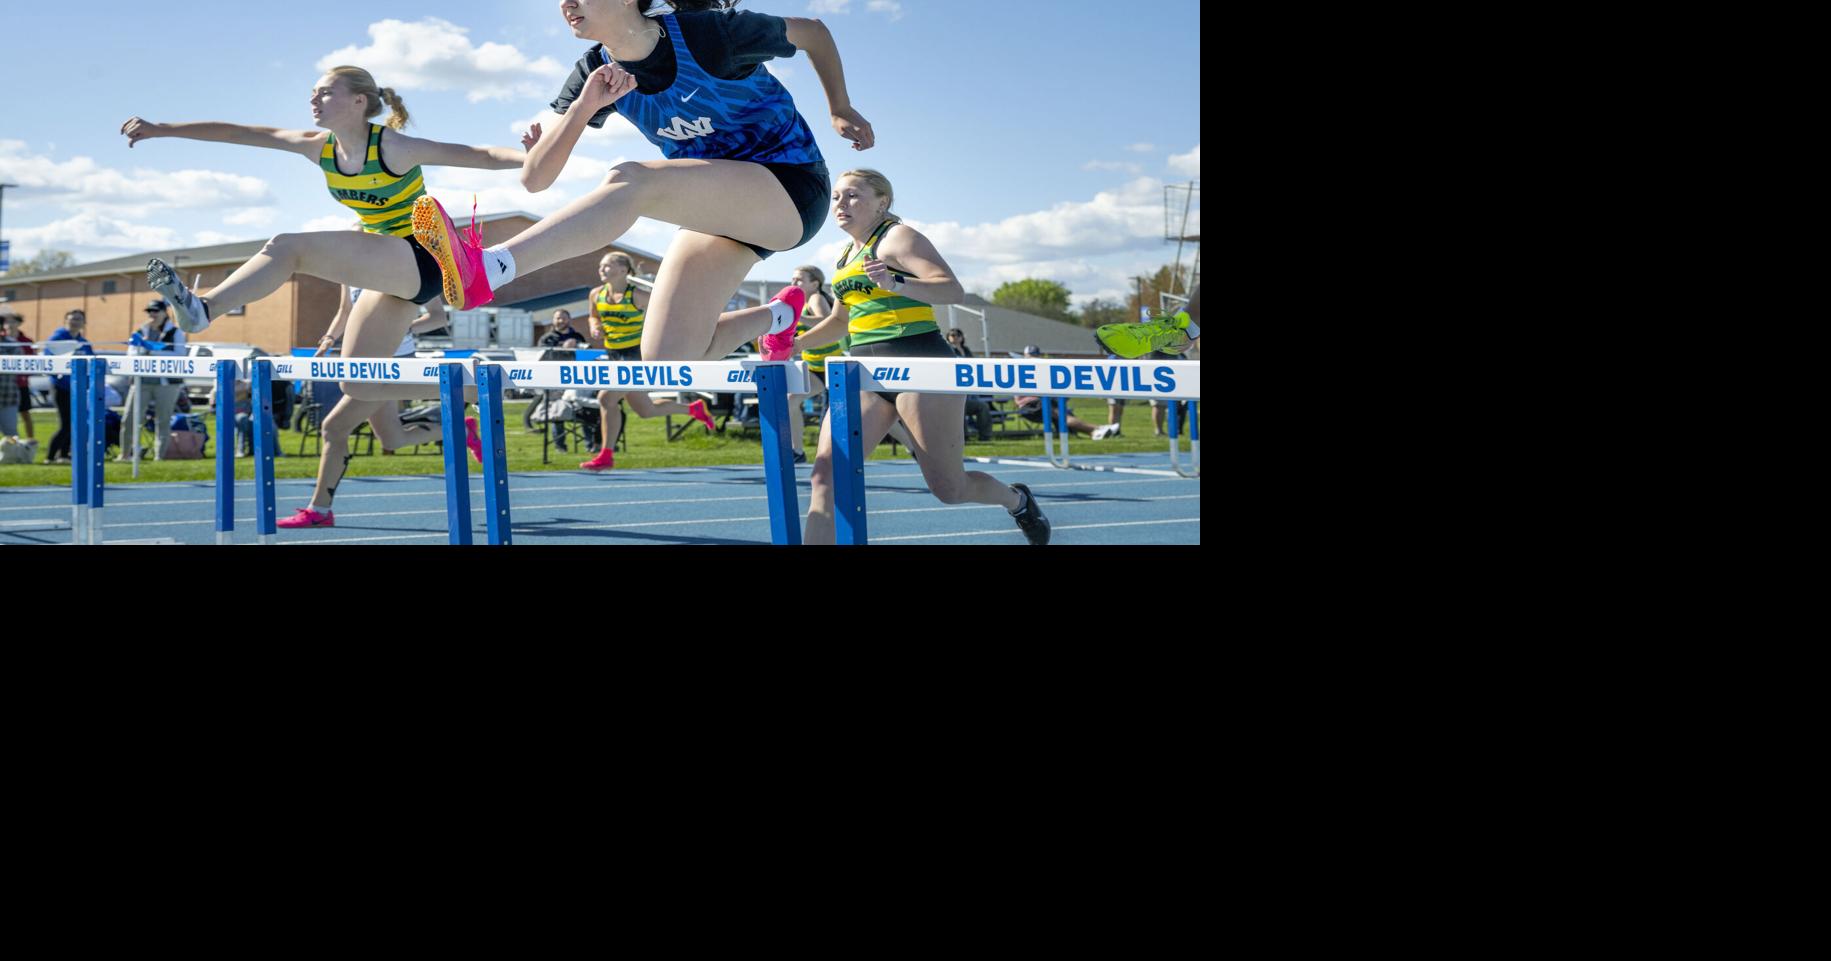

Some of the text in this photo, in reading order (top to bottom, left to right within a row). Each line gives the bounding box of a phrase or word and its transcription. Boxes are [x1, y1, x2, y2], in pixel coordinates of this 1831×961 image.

[1, 358, 22, 371] BLUE
[24, 358, 54, 372] DEVILS
[133, 359, 157, 373] BLUE
[160, 360, 194, 374] DEVILS
[276, 362, 439, 379] GILL BLUE DEVILS GIL
[508, 369, 533, 380] GILL
[560, 365, 610, 385] BLUE
[617, 365, 693, 386] DEVILS
[872, 363, 1176, 393] GILL BLUE DEVILS
